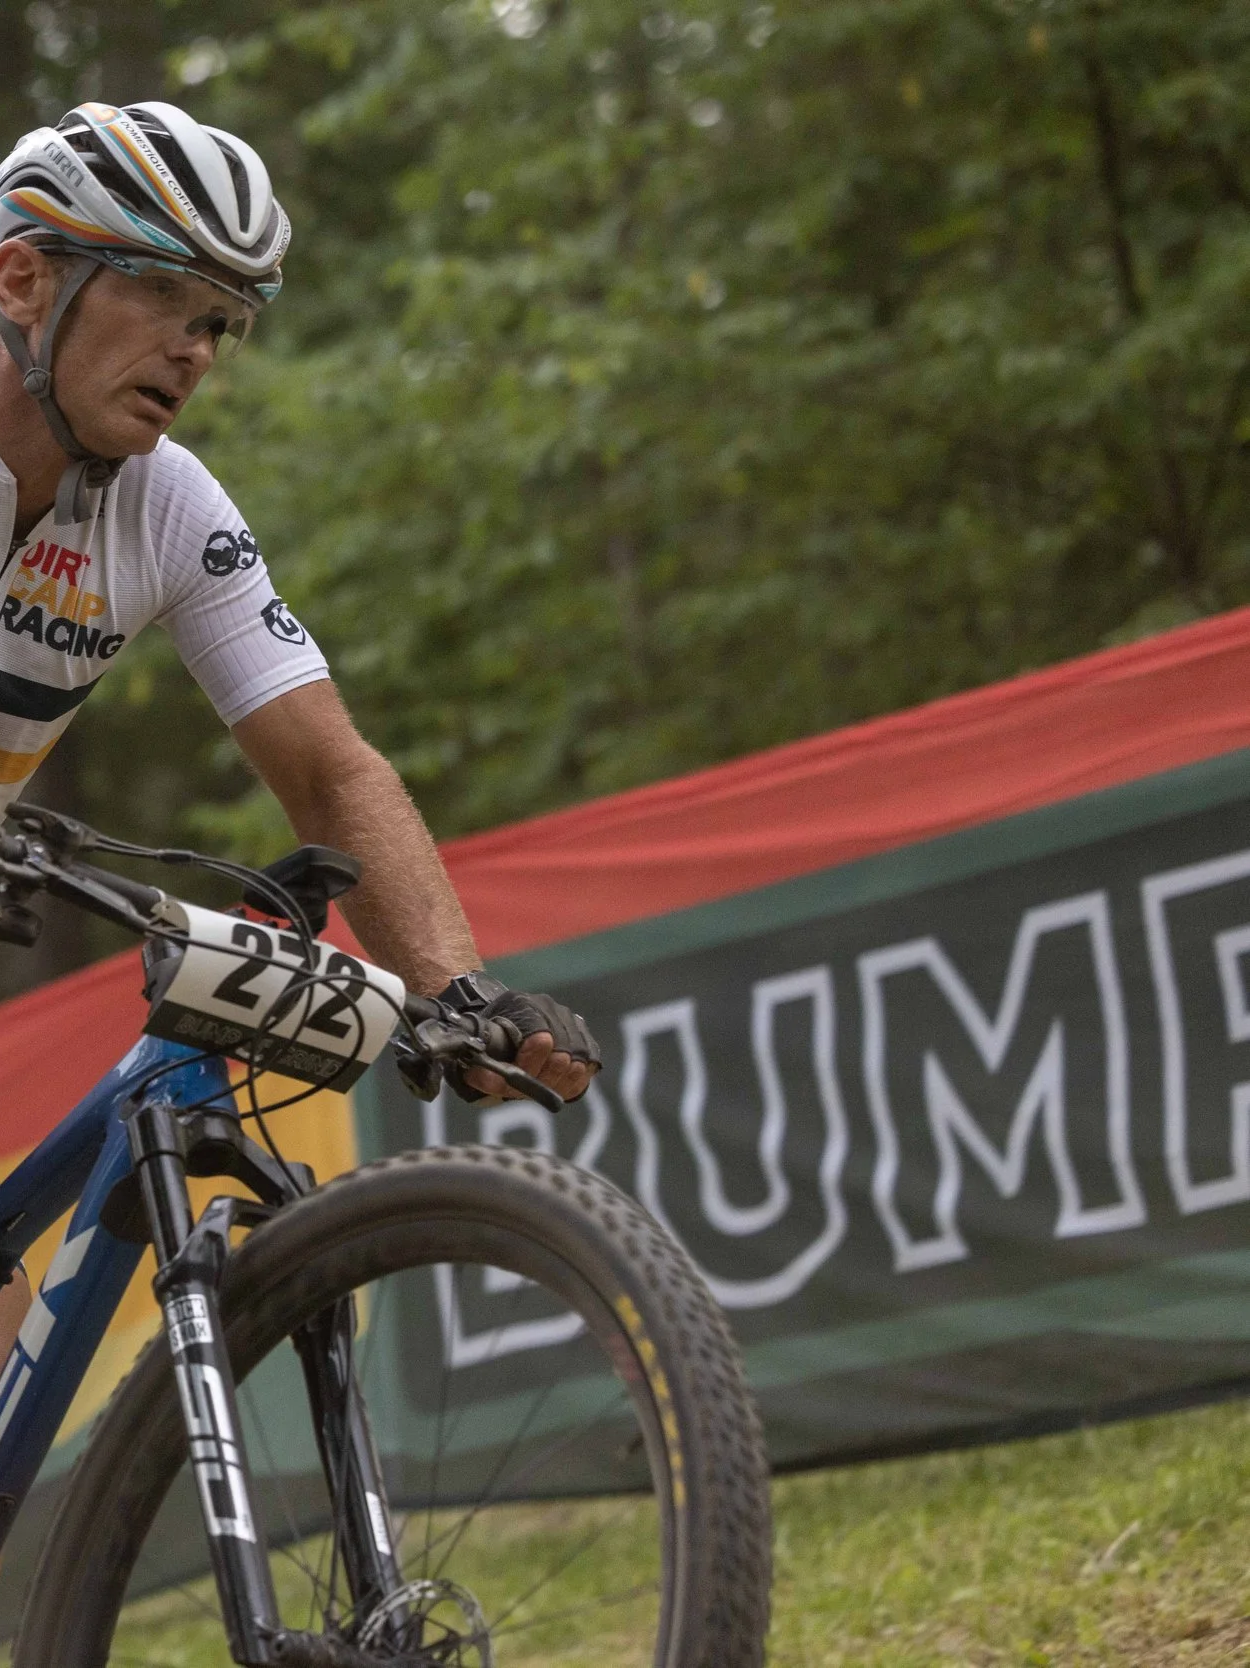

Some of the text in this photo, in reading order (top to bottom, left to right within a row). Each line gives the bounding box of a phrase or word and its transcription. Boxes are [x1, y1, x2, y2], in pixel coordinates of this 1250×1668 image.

[43, 142, 85, 188] GIRO
[120, 121, 169, 178] DOMESTIQUE
[168, 179, 199, 222] COFFEE
